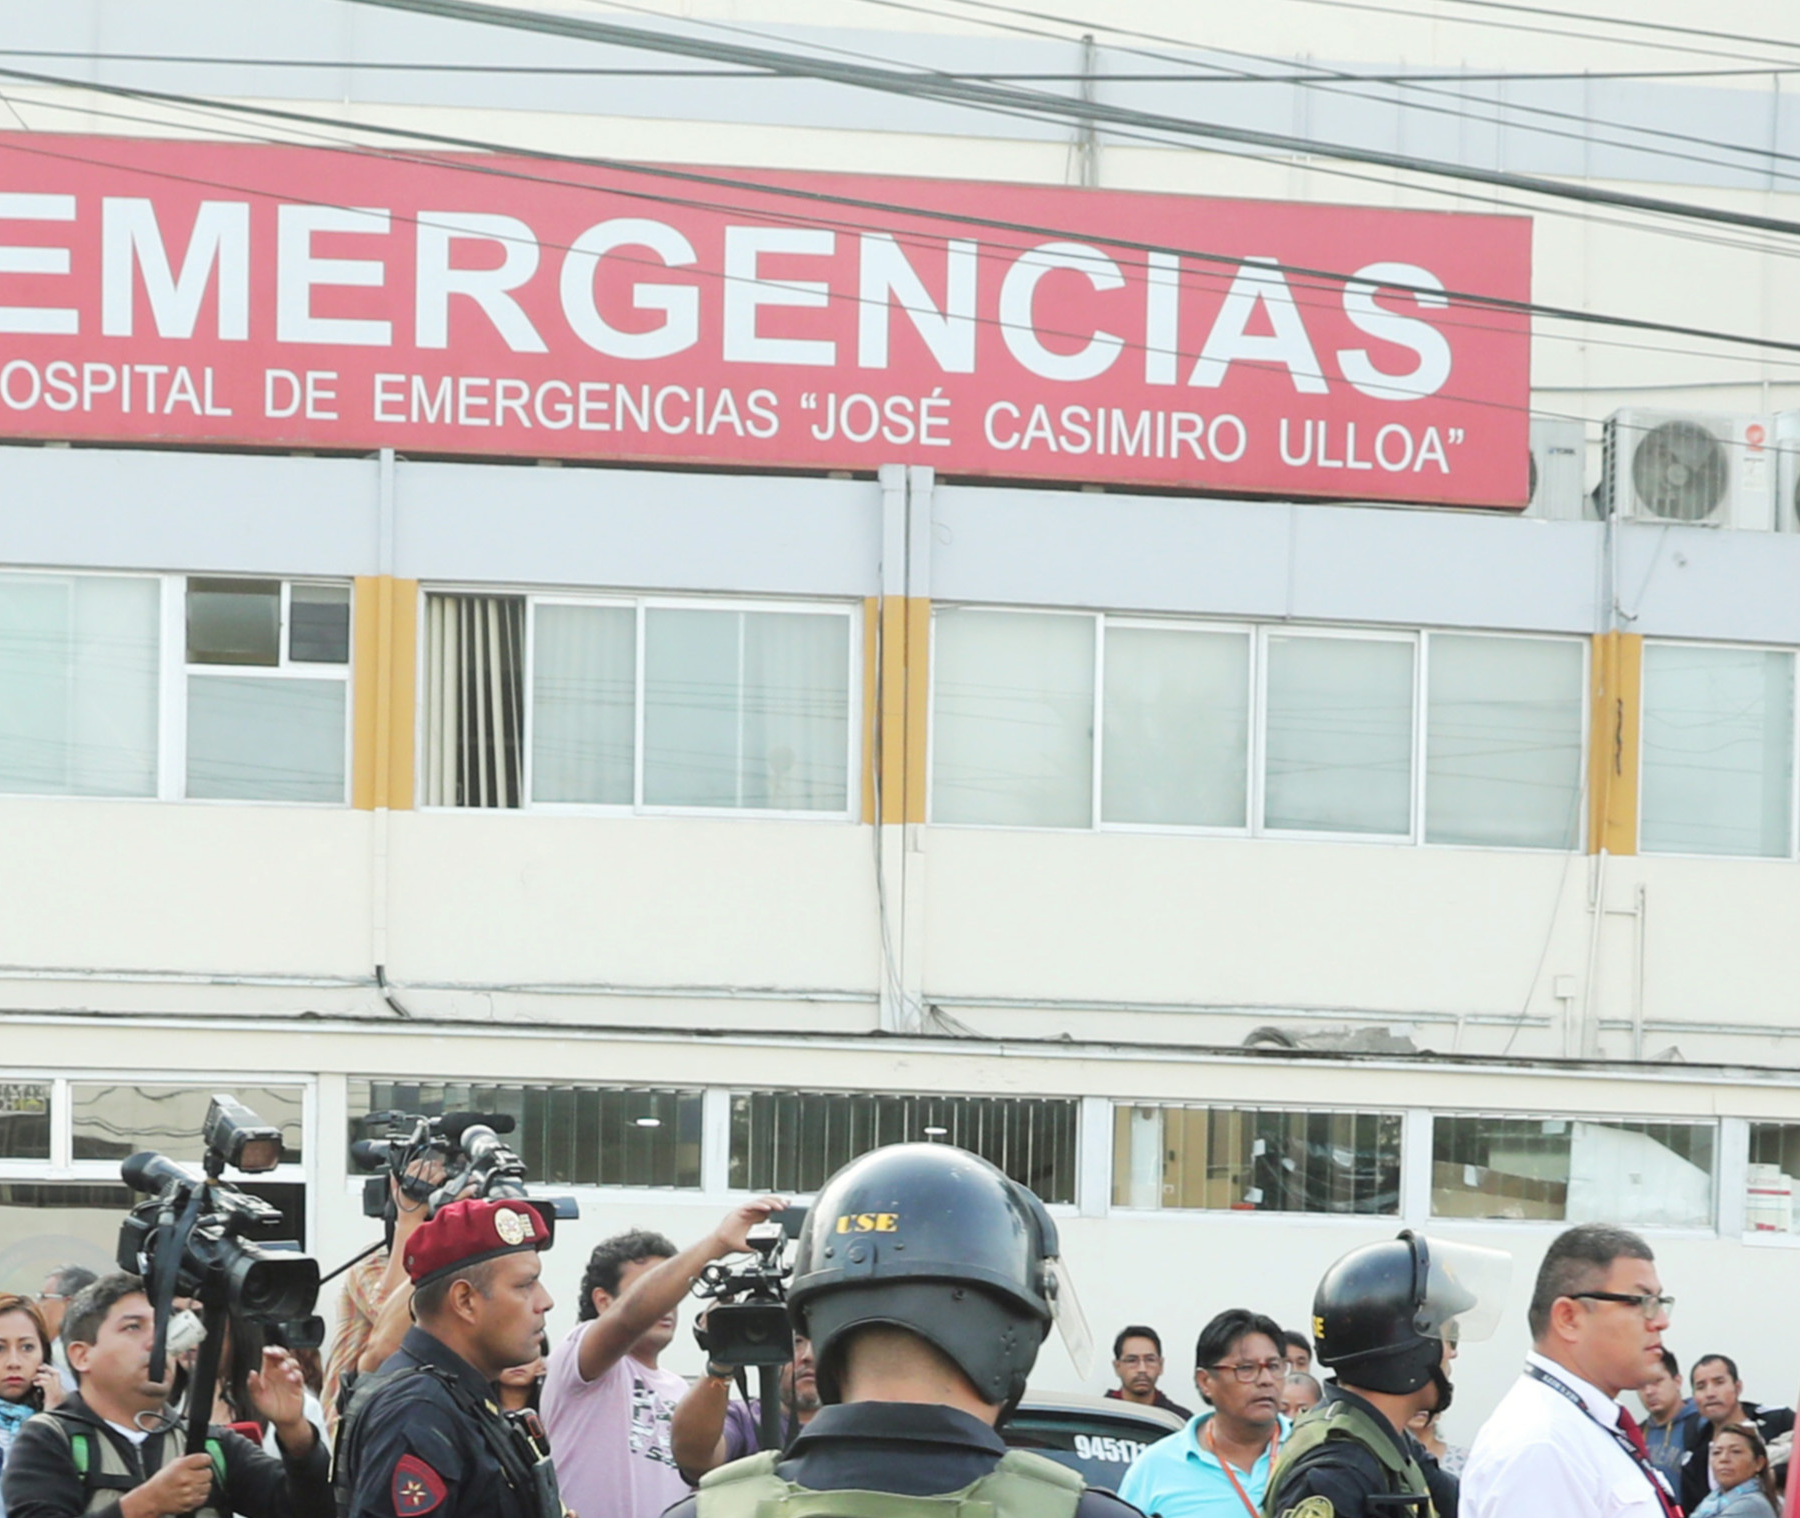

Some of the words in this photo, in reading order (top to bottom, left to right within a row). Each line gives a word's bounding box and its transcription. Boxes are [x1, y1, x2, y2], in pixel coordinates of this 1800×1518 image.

[263, 367, 340, 422] DE
[372, 371, 781, 440] EMERGENCIAS
[982, 400, 1248, 464] CASIMIRO
[835, 1212, 900, 1235] USE
